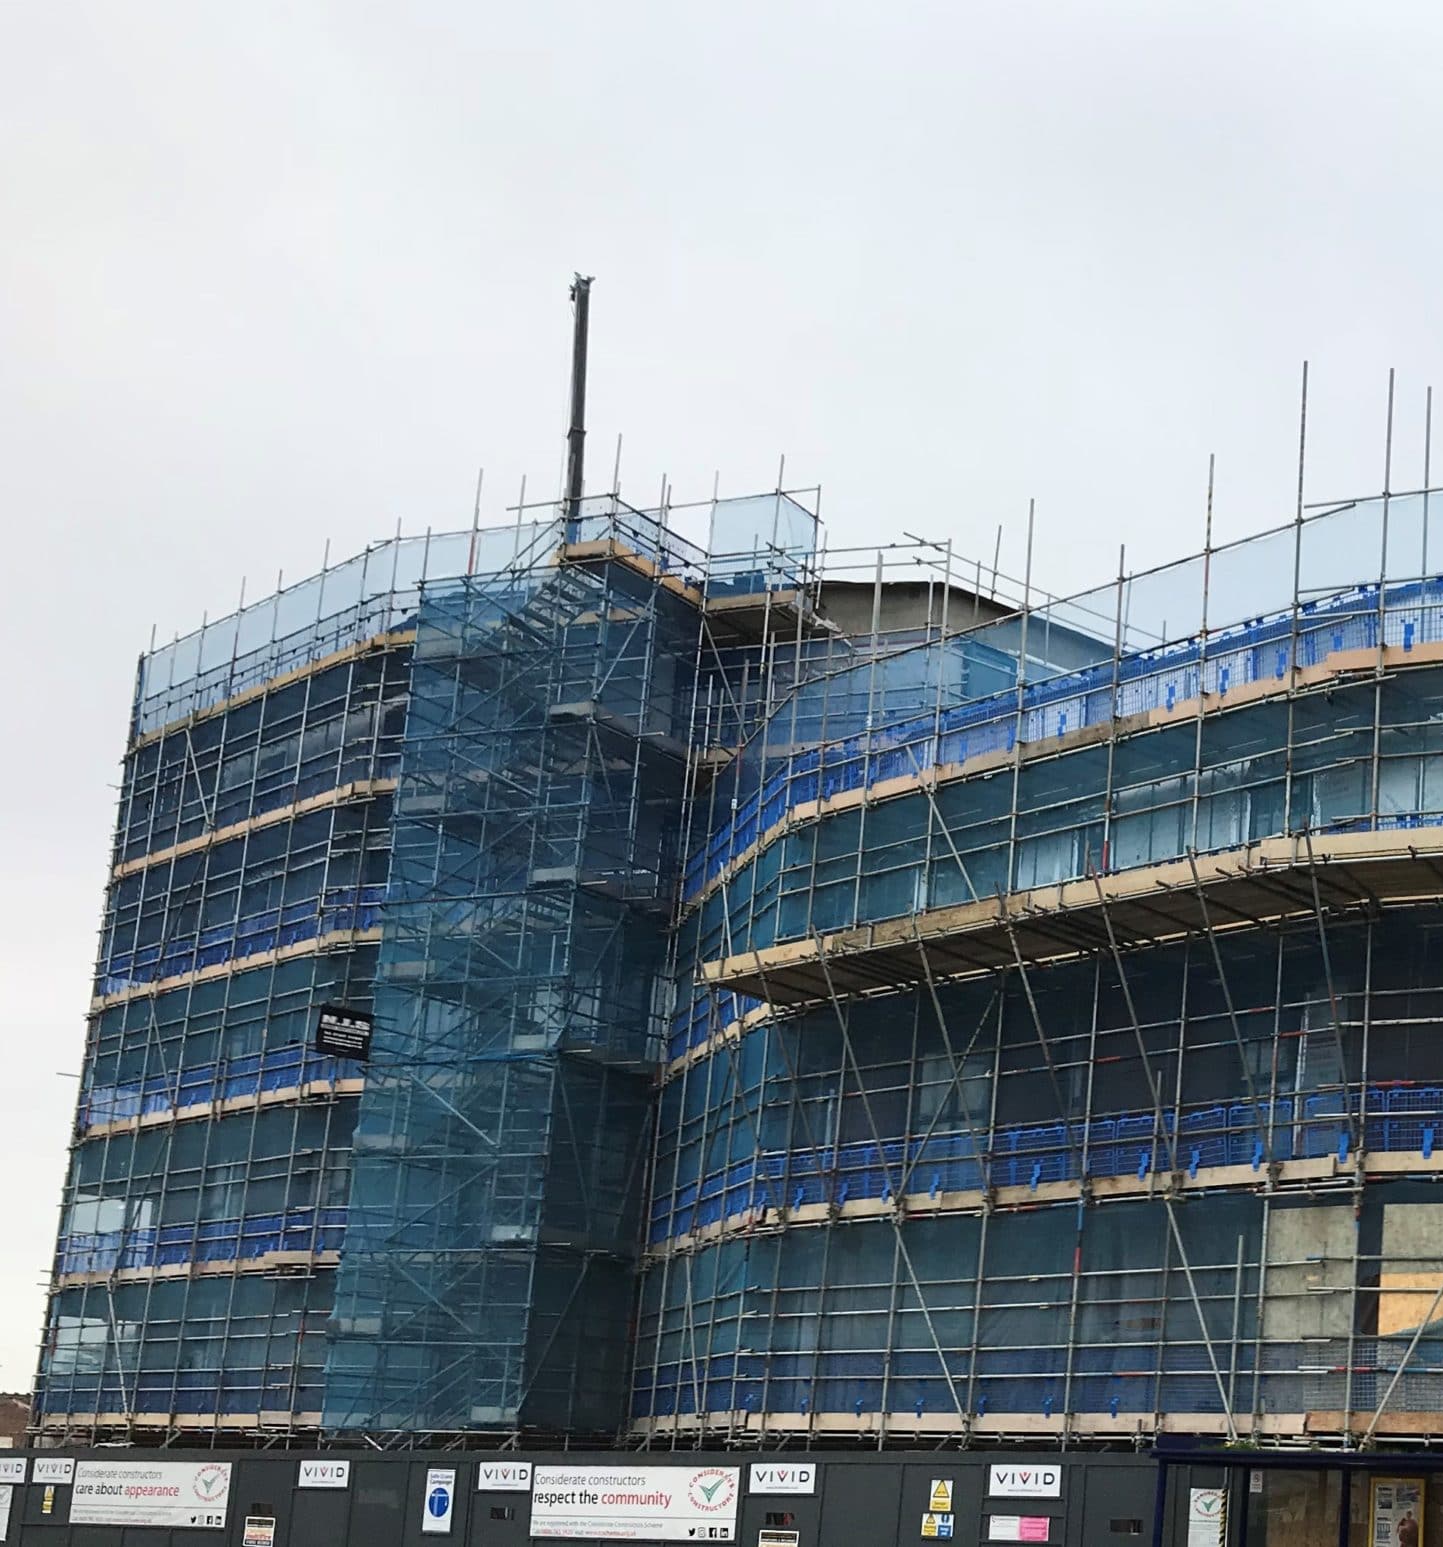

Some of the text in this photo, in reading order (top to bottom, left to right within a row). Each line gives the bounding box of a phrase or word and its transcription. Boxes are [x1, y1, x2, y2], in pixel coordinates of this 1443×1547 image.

[37, 1463, 72, 1474] VIVID
[77, 1467, 162, 1480] Considerate constructors
[304, 1466, 344, 1478] VIVID
[483, 1468, 528, 1480] VIVID
[535, 1472, 646, 1486] Considerate constructors
[689, 1468, 735, 1489] CONSIDERATE
[755, 1470, 810, 1482] VIVID
[996, 1471, 1055, 1485] VIVID
[75, 1482, 180, 1500] care about appearance
[534, 1490, 672, 1509] respect the community
